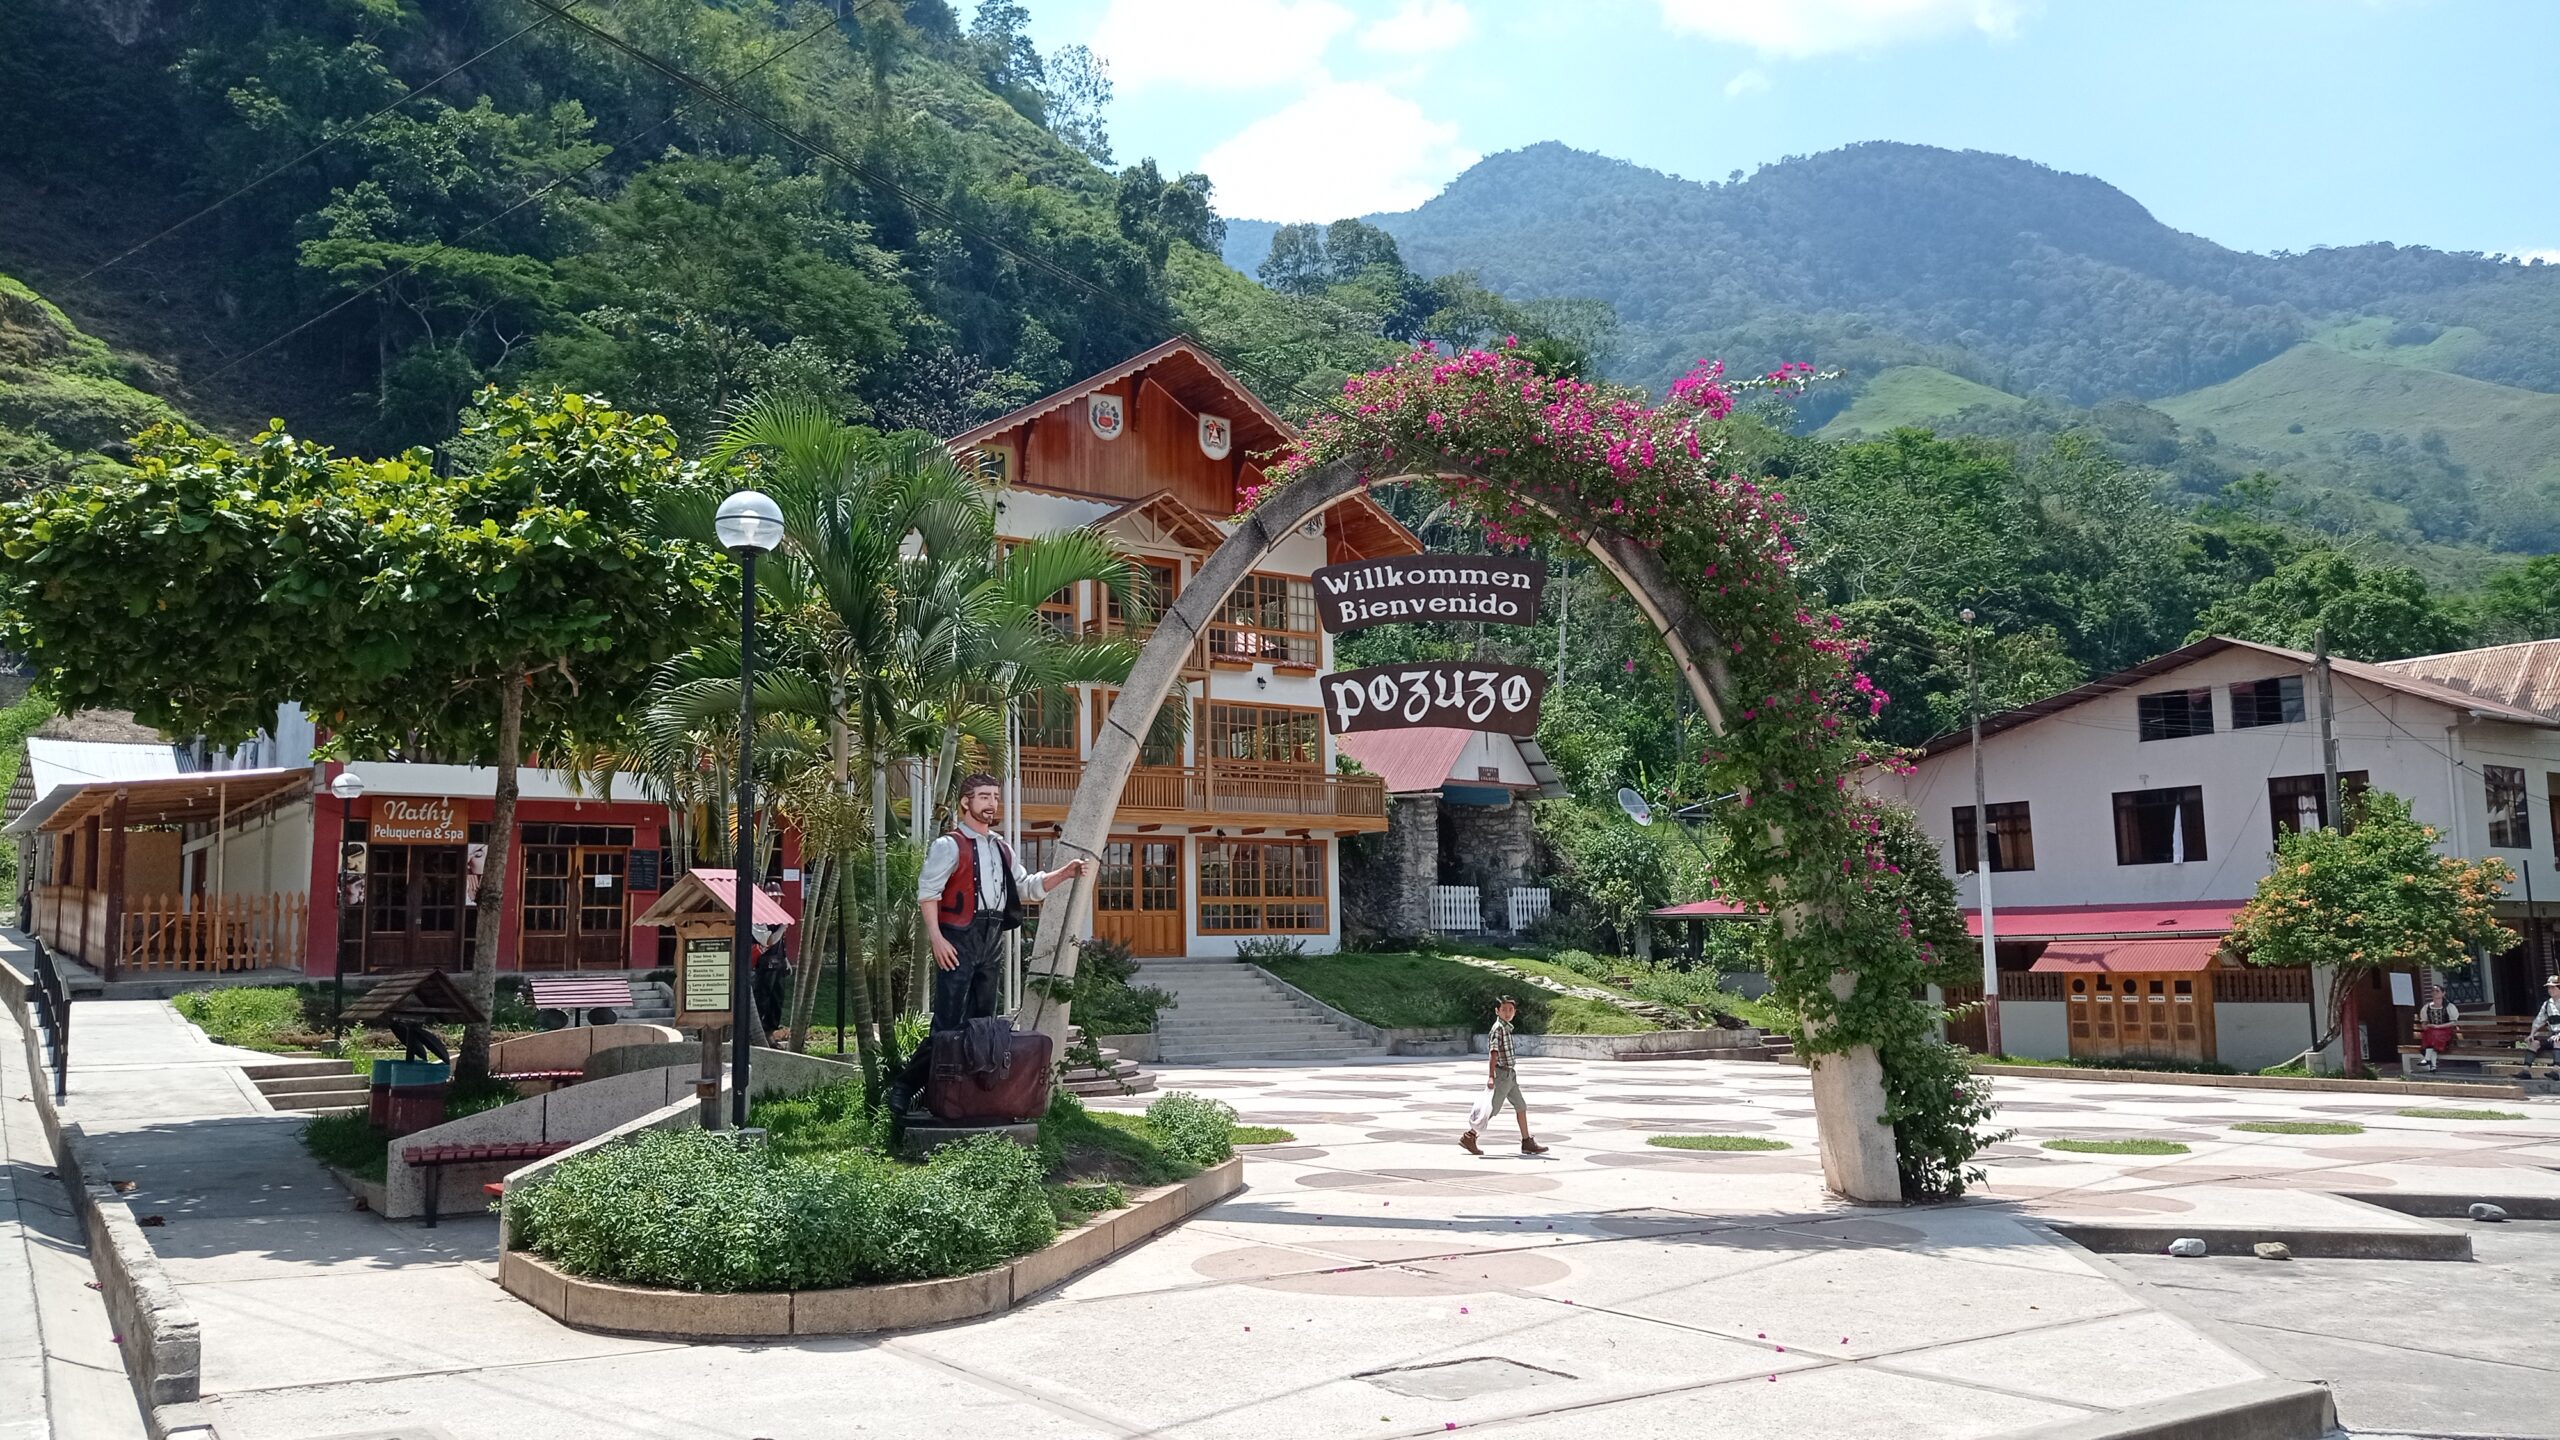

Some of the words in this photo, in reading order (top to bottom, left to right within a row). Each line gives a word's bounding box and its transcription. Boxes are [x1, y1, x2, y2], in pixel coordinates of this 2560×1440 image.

[1321, 565, 1531, 595] Willkommen
[1338, 593, 1518, 623] Bienvenido
[384, 801, 454, 829] Nathy
[374, 824, 432, 841] Peluquería
[433, 827, 442, 839] &
[444, 830, 464, 842] spa
